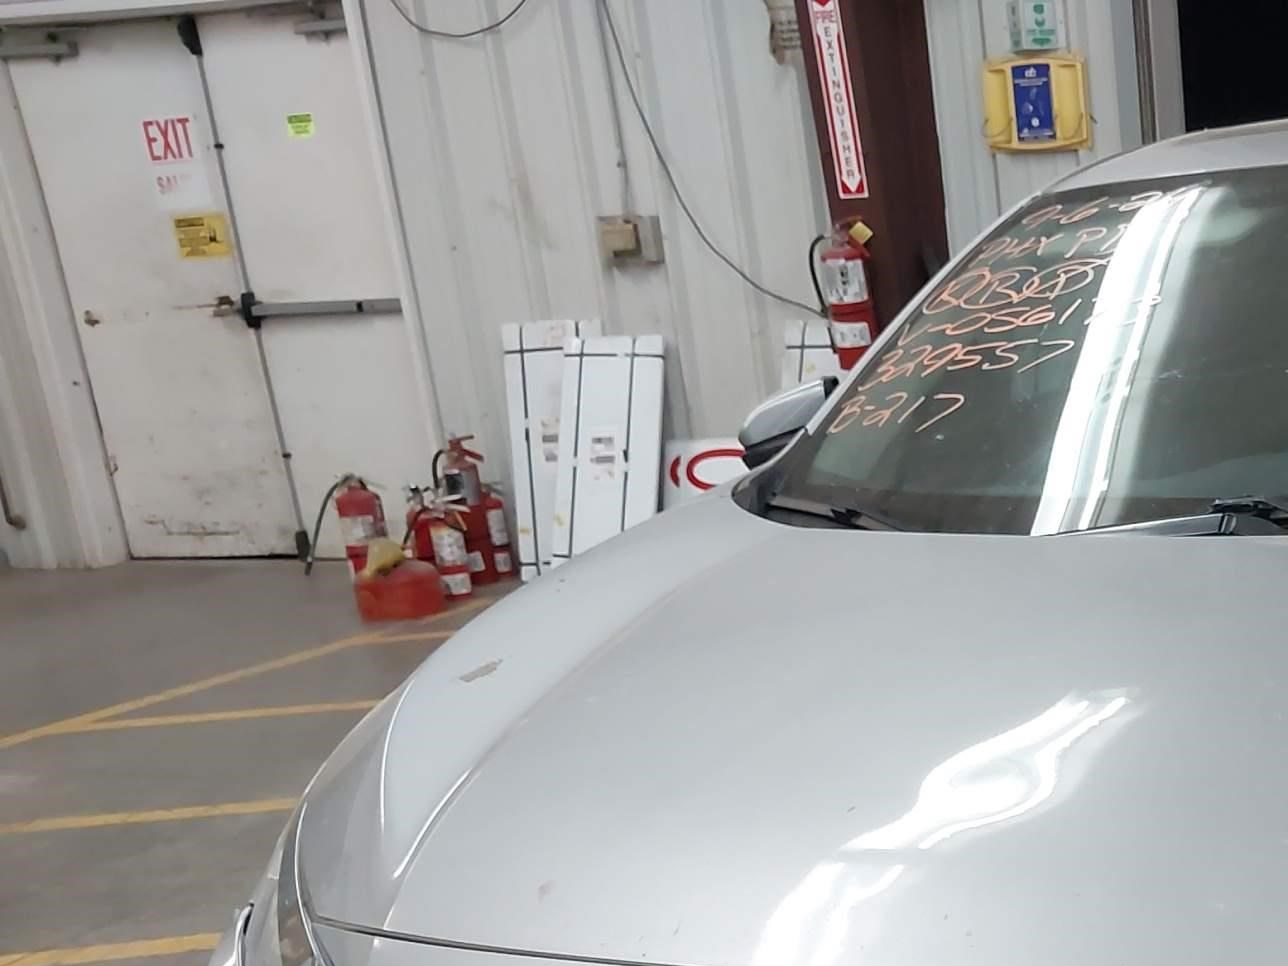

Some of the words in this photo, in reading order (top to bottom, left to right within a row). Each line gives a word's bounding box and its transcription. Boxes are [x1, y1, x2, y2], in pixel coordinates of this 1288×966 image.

[823, 26, 856, 179] EXTINGUISHER
[143, 117, 193, 161] EXIT
[827, 392, 966, 434] B-217
